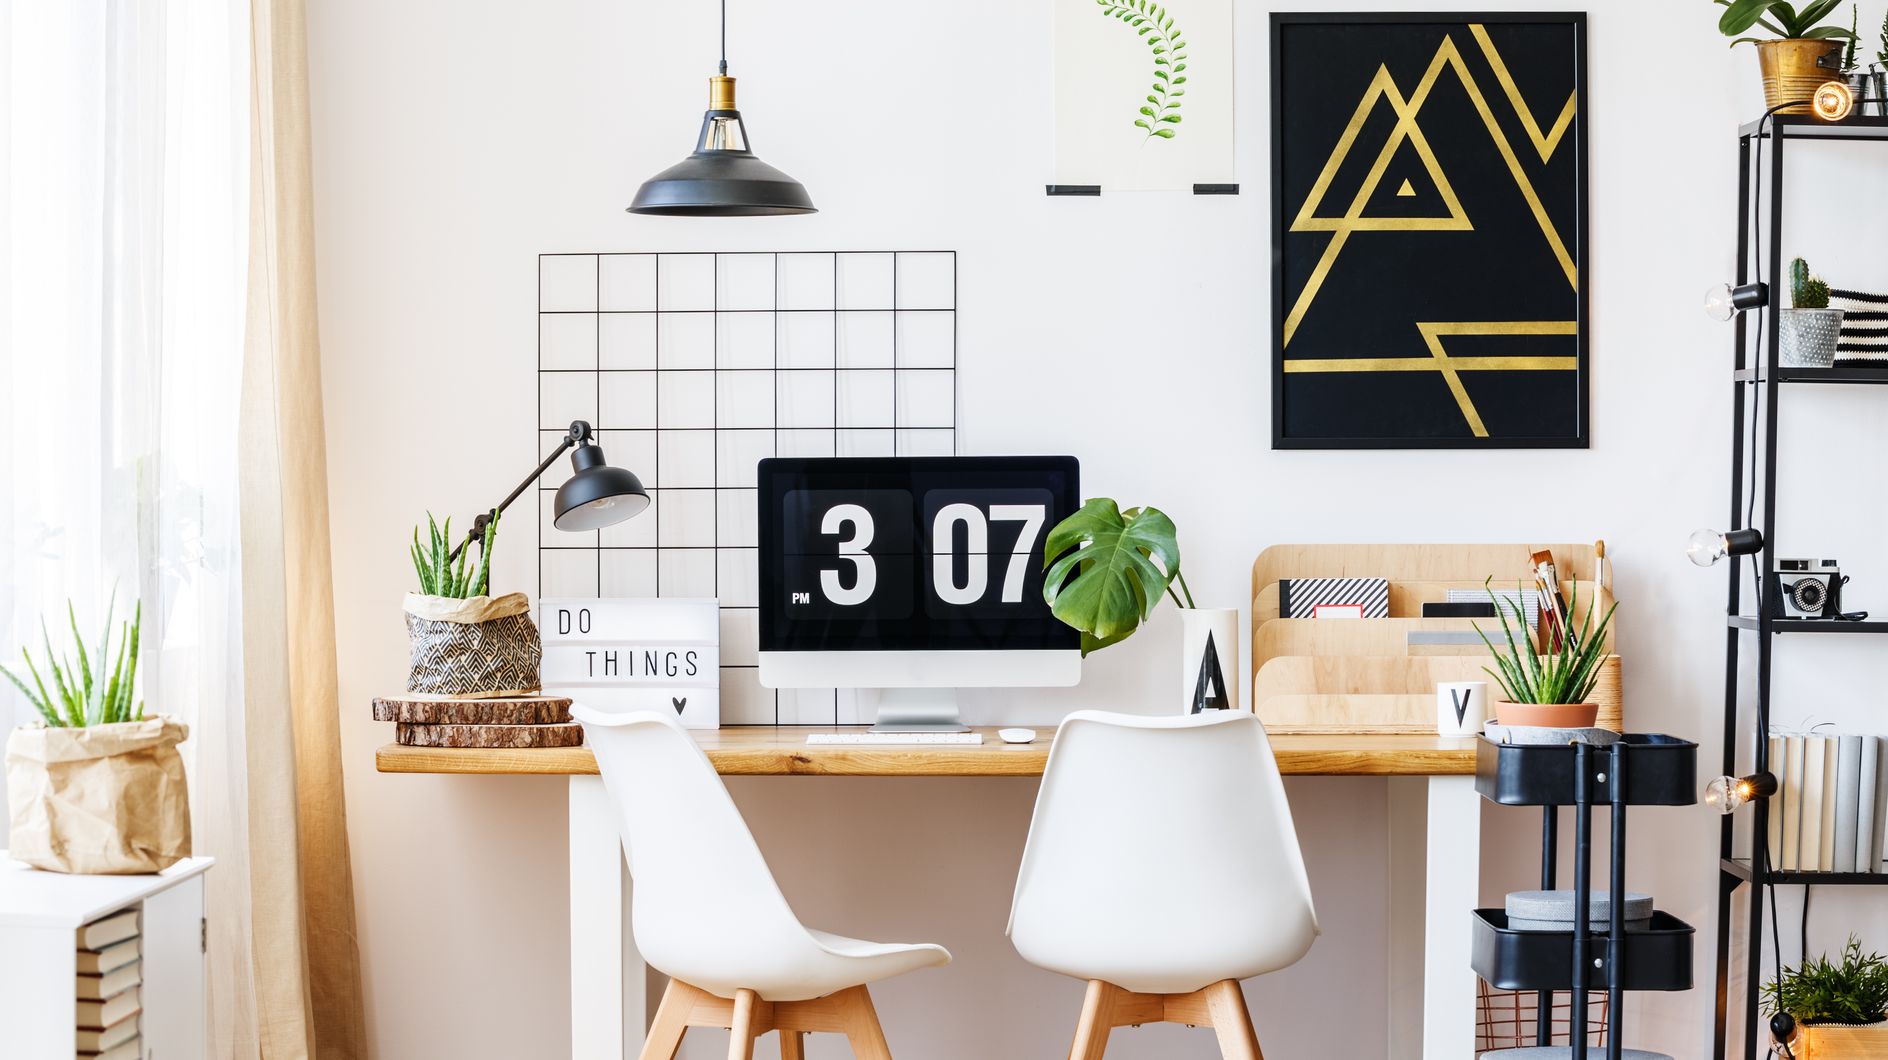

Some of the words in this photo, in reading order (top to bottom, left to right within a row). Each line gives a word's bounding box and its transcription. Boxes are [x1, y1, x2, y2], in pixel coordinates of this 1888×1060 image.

[819, 503, 877, 606] 3
[932, 502, 1046, 605] 07
[792, 592, 810, 605] PM
[558, 608, 591, 635] DO
[585, 650, 697, 678] THINGS
[1190, 629, 1230, 715] A
[1450, 688, 1471, 728] V
